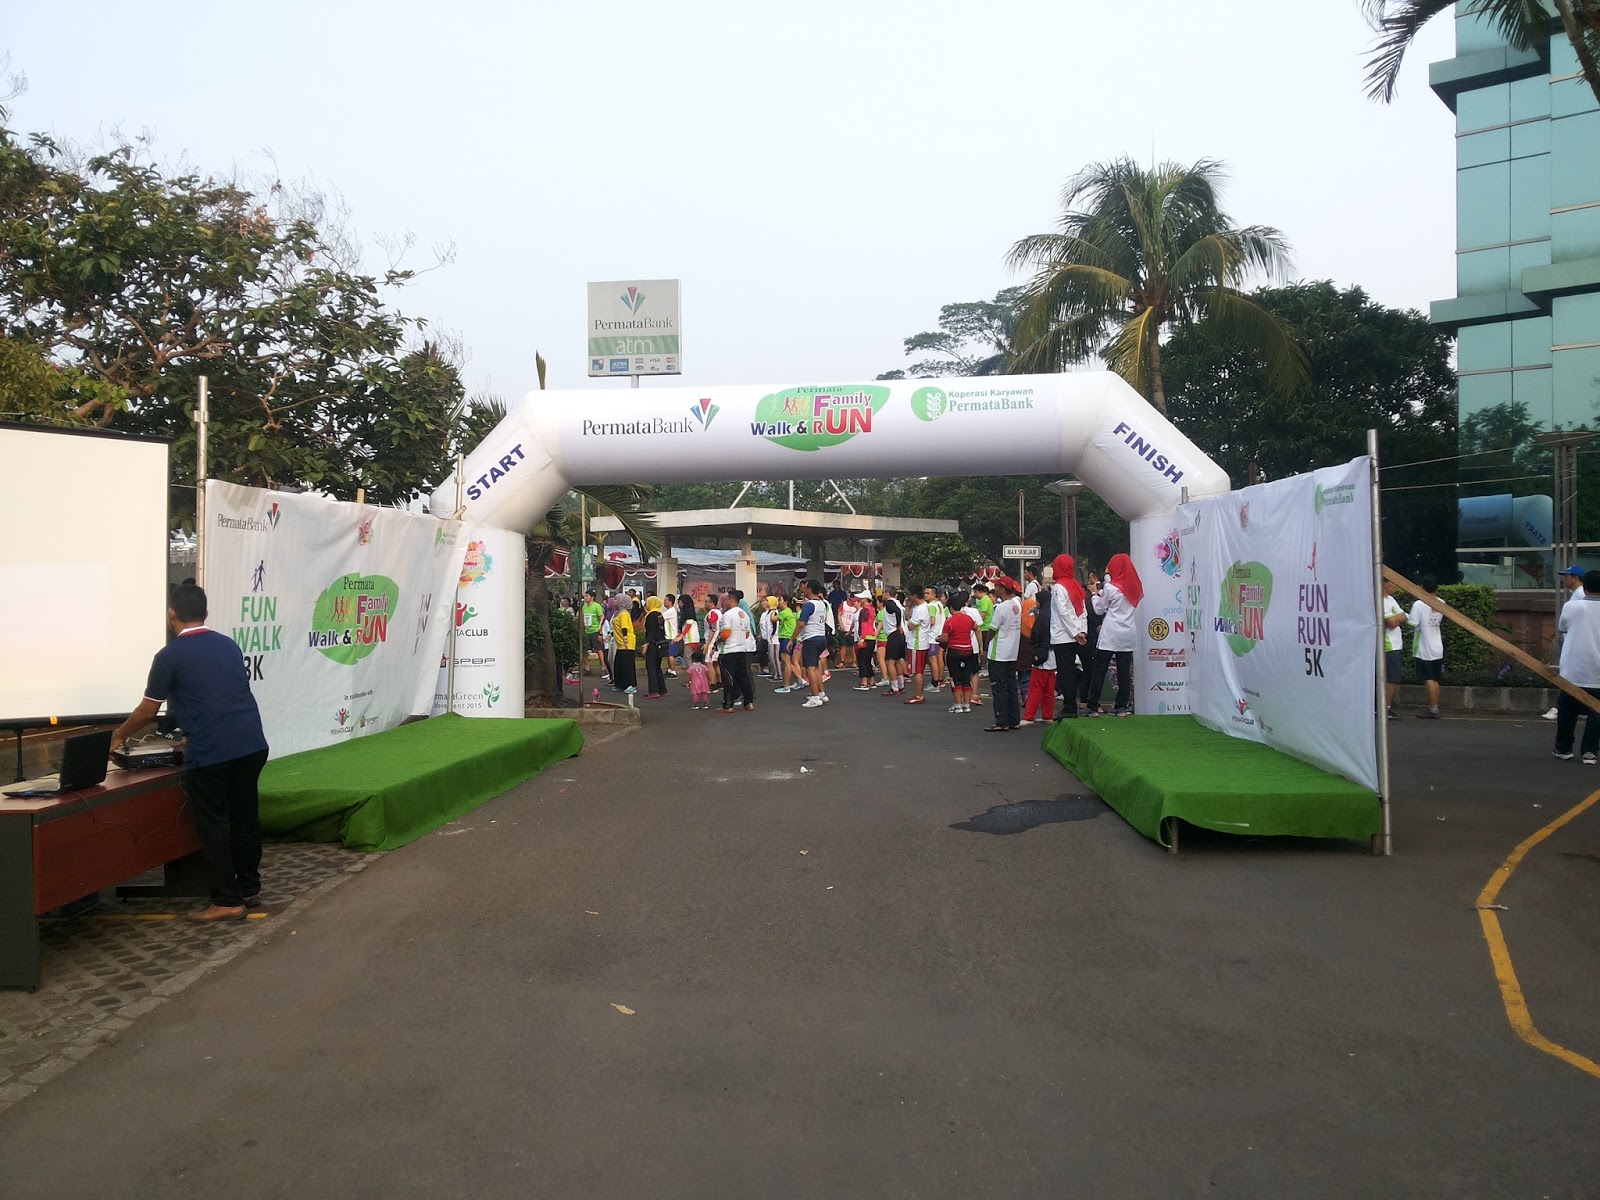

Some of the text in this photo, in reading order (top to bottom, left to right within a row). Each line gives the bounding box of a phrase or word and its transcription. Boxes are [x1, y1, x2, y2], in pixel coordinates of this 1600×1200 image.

[594, 317, 673, 330] PermataBank
[616, 338, 652, 354] atm
[797, 386, 842, 394] Permata
[949, 389, 1034, 398] Koperasi Karyawan
[813, 391, 872, 418] Family
[949, 397, 1034, 411] PermataBank
[582, 417, 693, 435] PermataBank
[751, 408, 872, 436] Walk & RUN
[1113, 421, 1184, 484] FINISH
[466, 443, 525, 500] START
[217, 513, 268, 531] PermataBank
[343, 576, 375, 590] Permata
[241, 596, 277, 622] FUN
[356, 593, 389, 625] Family
[1163, 606, 1183, 616] gard
[1239, 581, 1264, 615] Family
[1299, 584, 1328, 613] FUN
[232, 625, 282, 653] WALK
[308, 615, 388, 647] Walk & RUN
[1298, 616, 1330, 646] RUN
[1305, 648, 1324, 677] 5K
